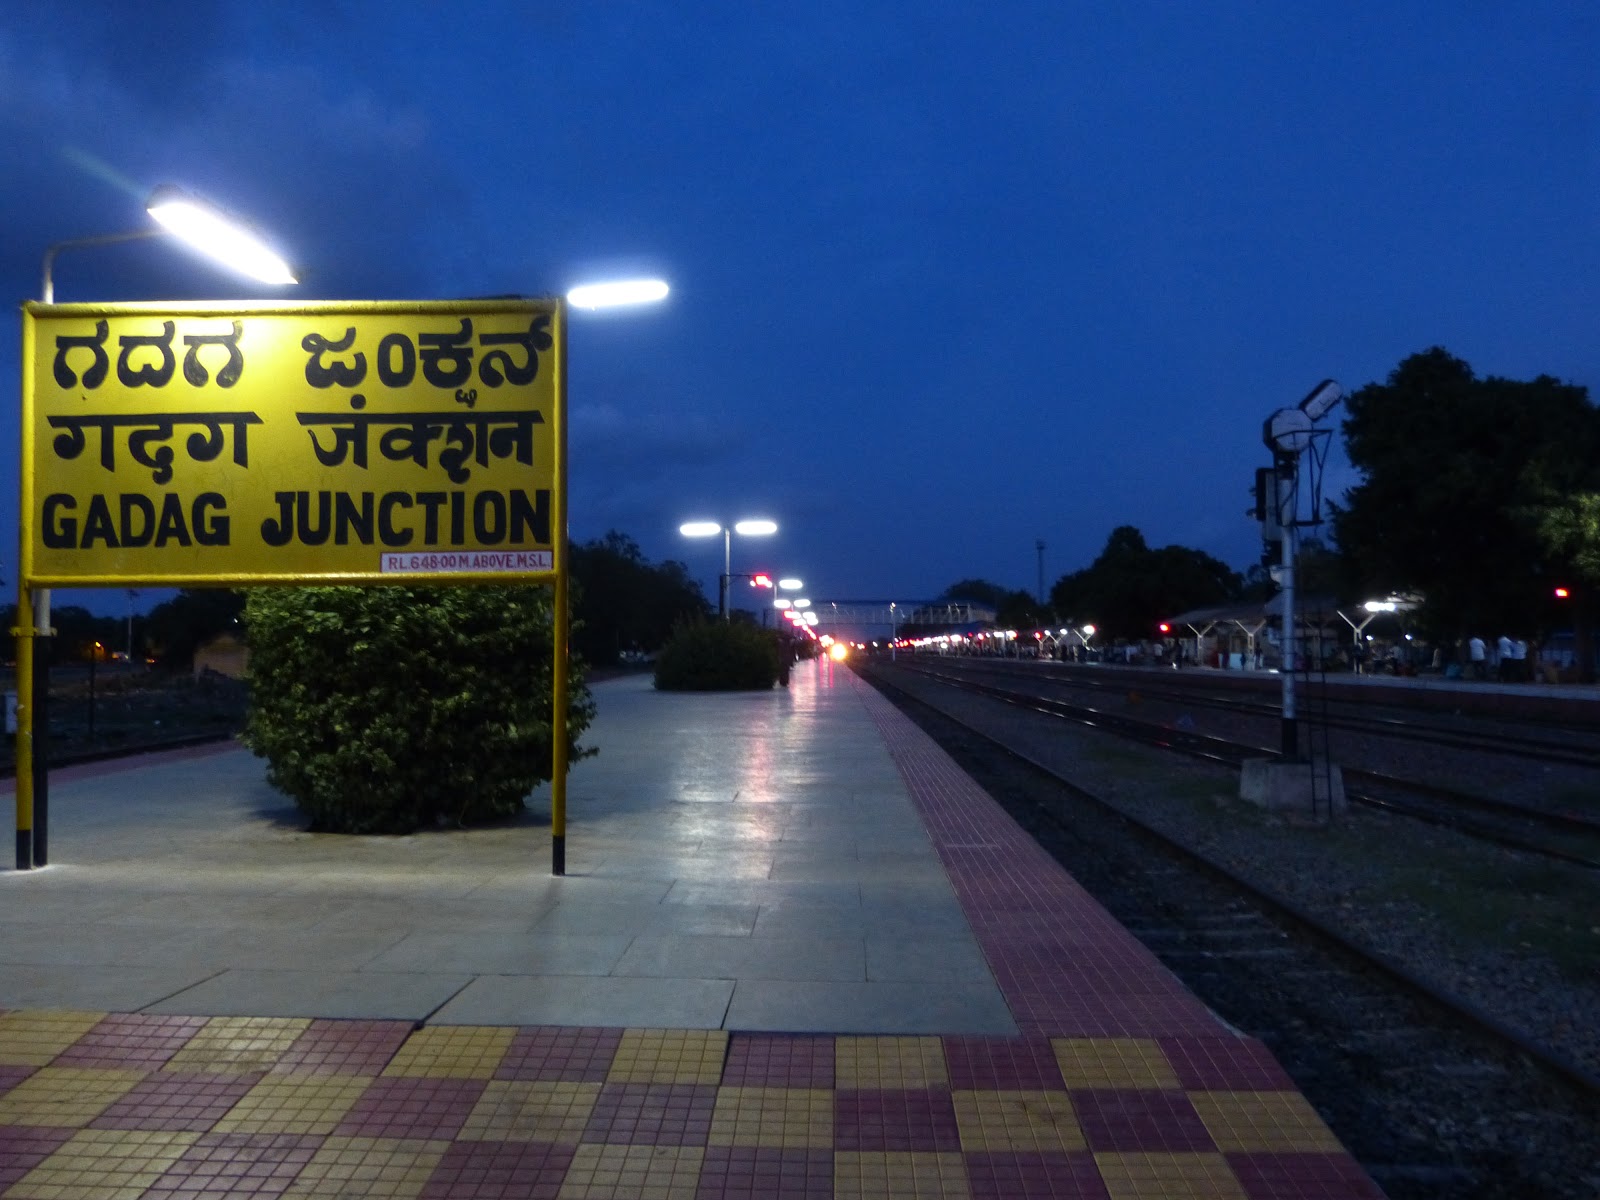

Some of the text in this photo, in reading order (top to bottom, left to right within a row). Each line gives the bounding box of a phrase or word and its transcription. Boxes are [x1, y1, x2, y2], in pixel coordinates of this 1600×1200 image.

[53, 319, 244, 390] ಗದಗ
[46, 393, 545, 485] गदग जंक्शन
[42, 489, 550, 549] GADAG JUNCTION
